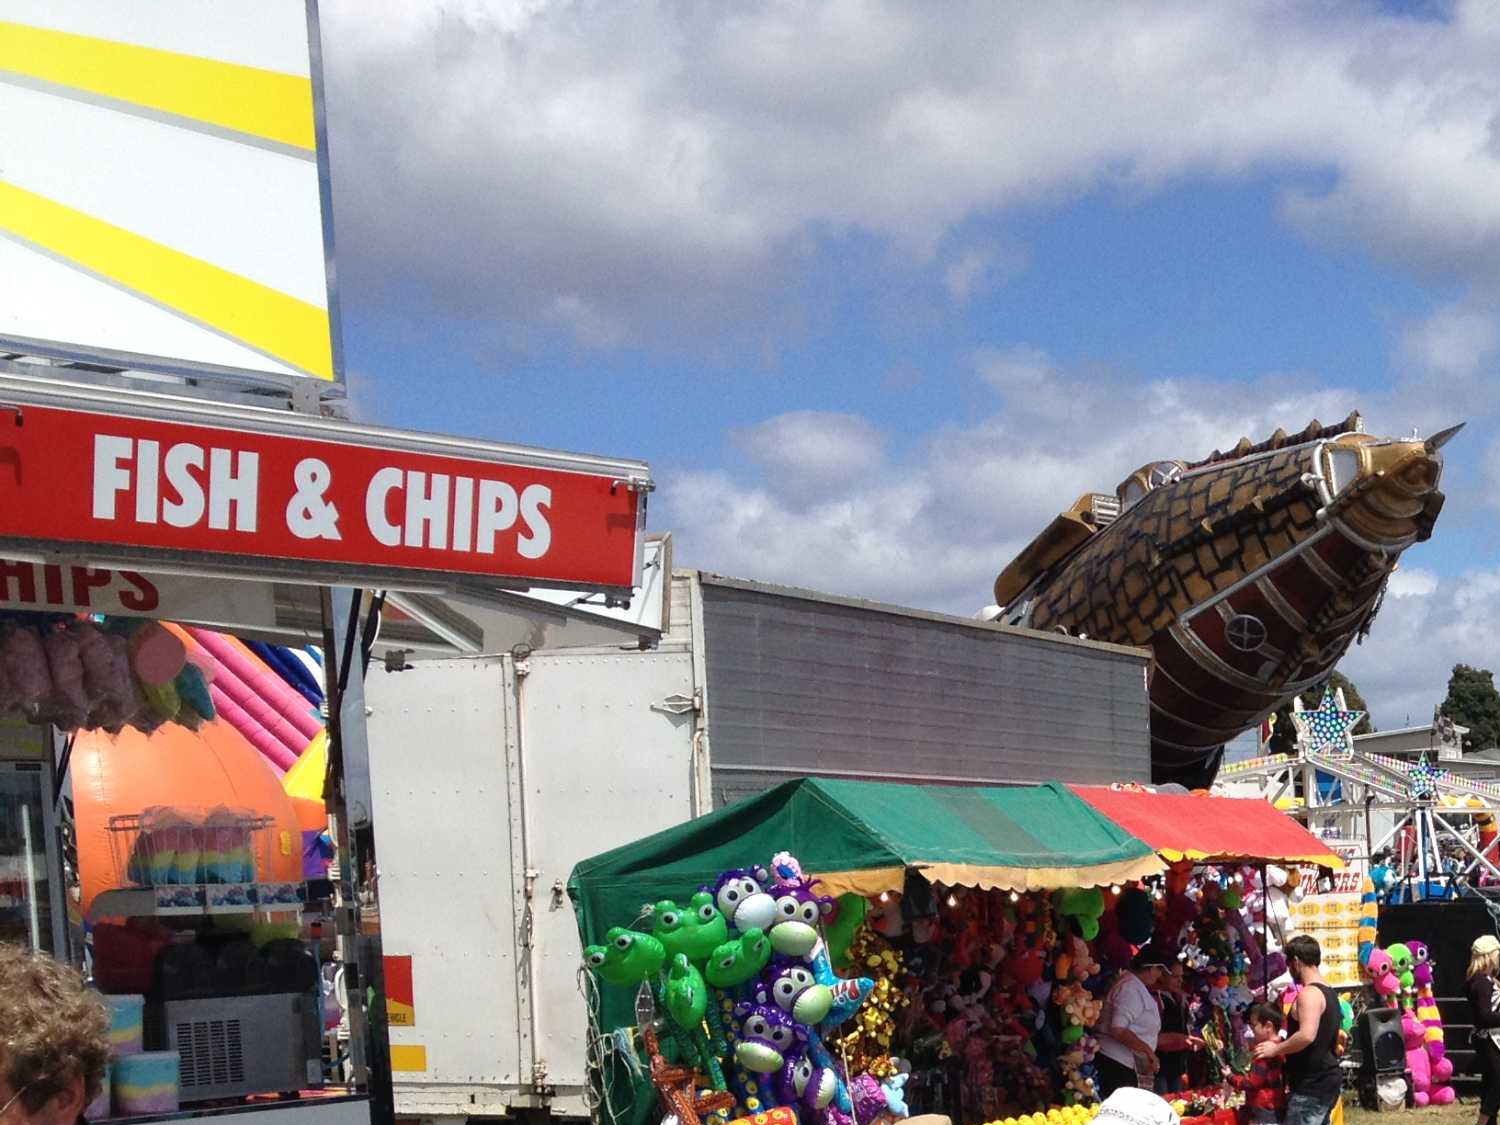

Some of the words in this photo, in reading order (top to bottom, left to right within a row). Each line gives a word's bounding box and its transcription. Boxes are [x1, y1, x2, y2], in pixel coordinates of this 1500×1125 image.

[93, 434, 260, 533] FISH
[286, 457, 343, 541] &
[365, 466, 552, 560] CHIPS
